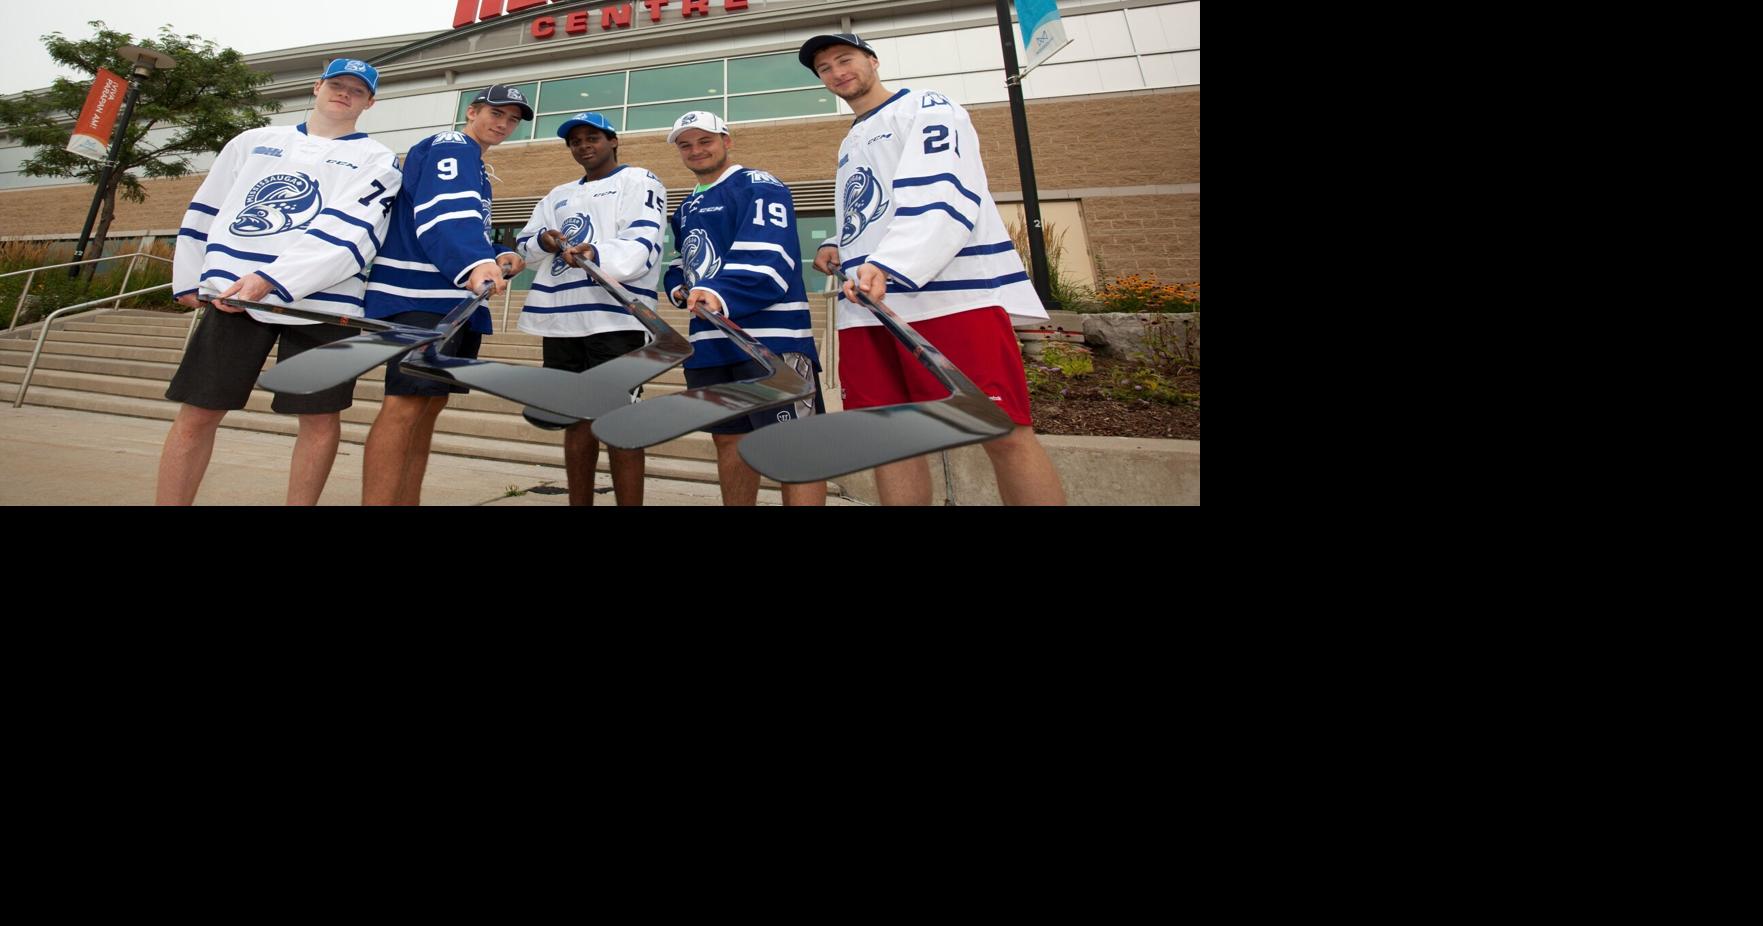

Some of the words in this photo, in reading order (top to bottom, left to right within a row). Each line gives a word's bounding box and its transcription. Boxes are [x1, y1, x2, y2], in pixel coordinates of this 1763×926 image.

[96, 79, 113, 113] PARAPAN
[325, 159, 359, 170] CCM
[437, 157, 458, 180] 9
[247, 174, 298, 204] MISSISSAUGA
[358, 179, 396, 218] 74
[644, 189, 665, 214] 15
[752, 198, 788, 229] 19
